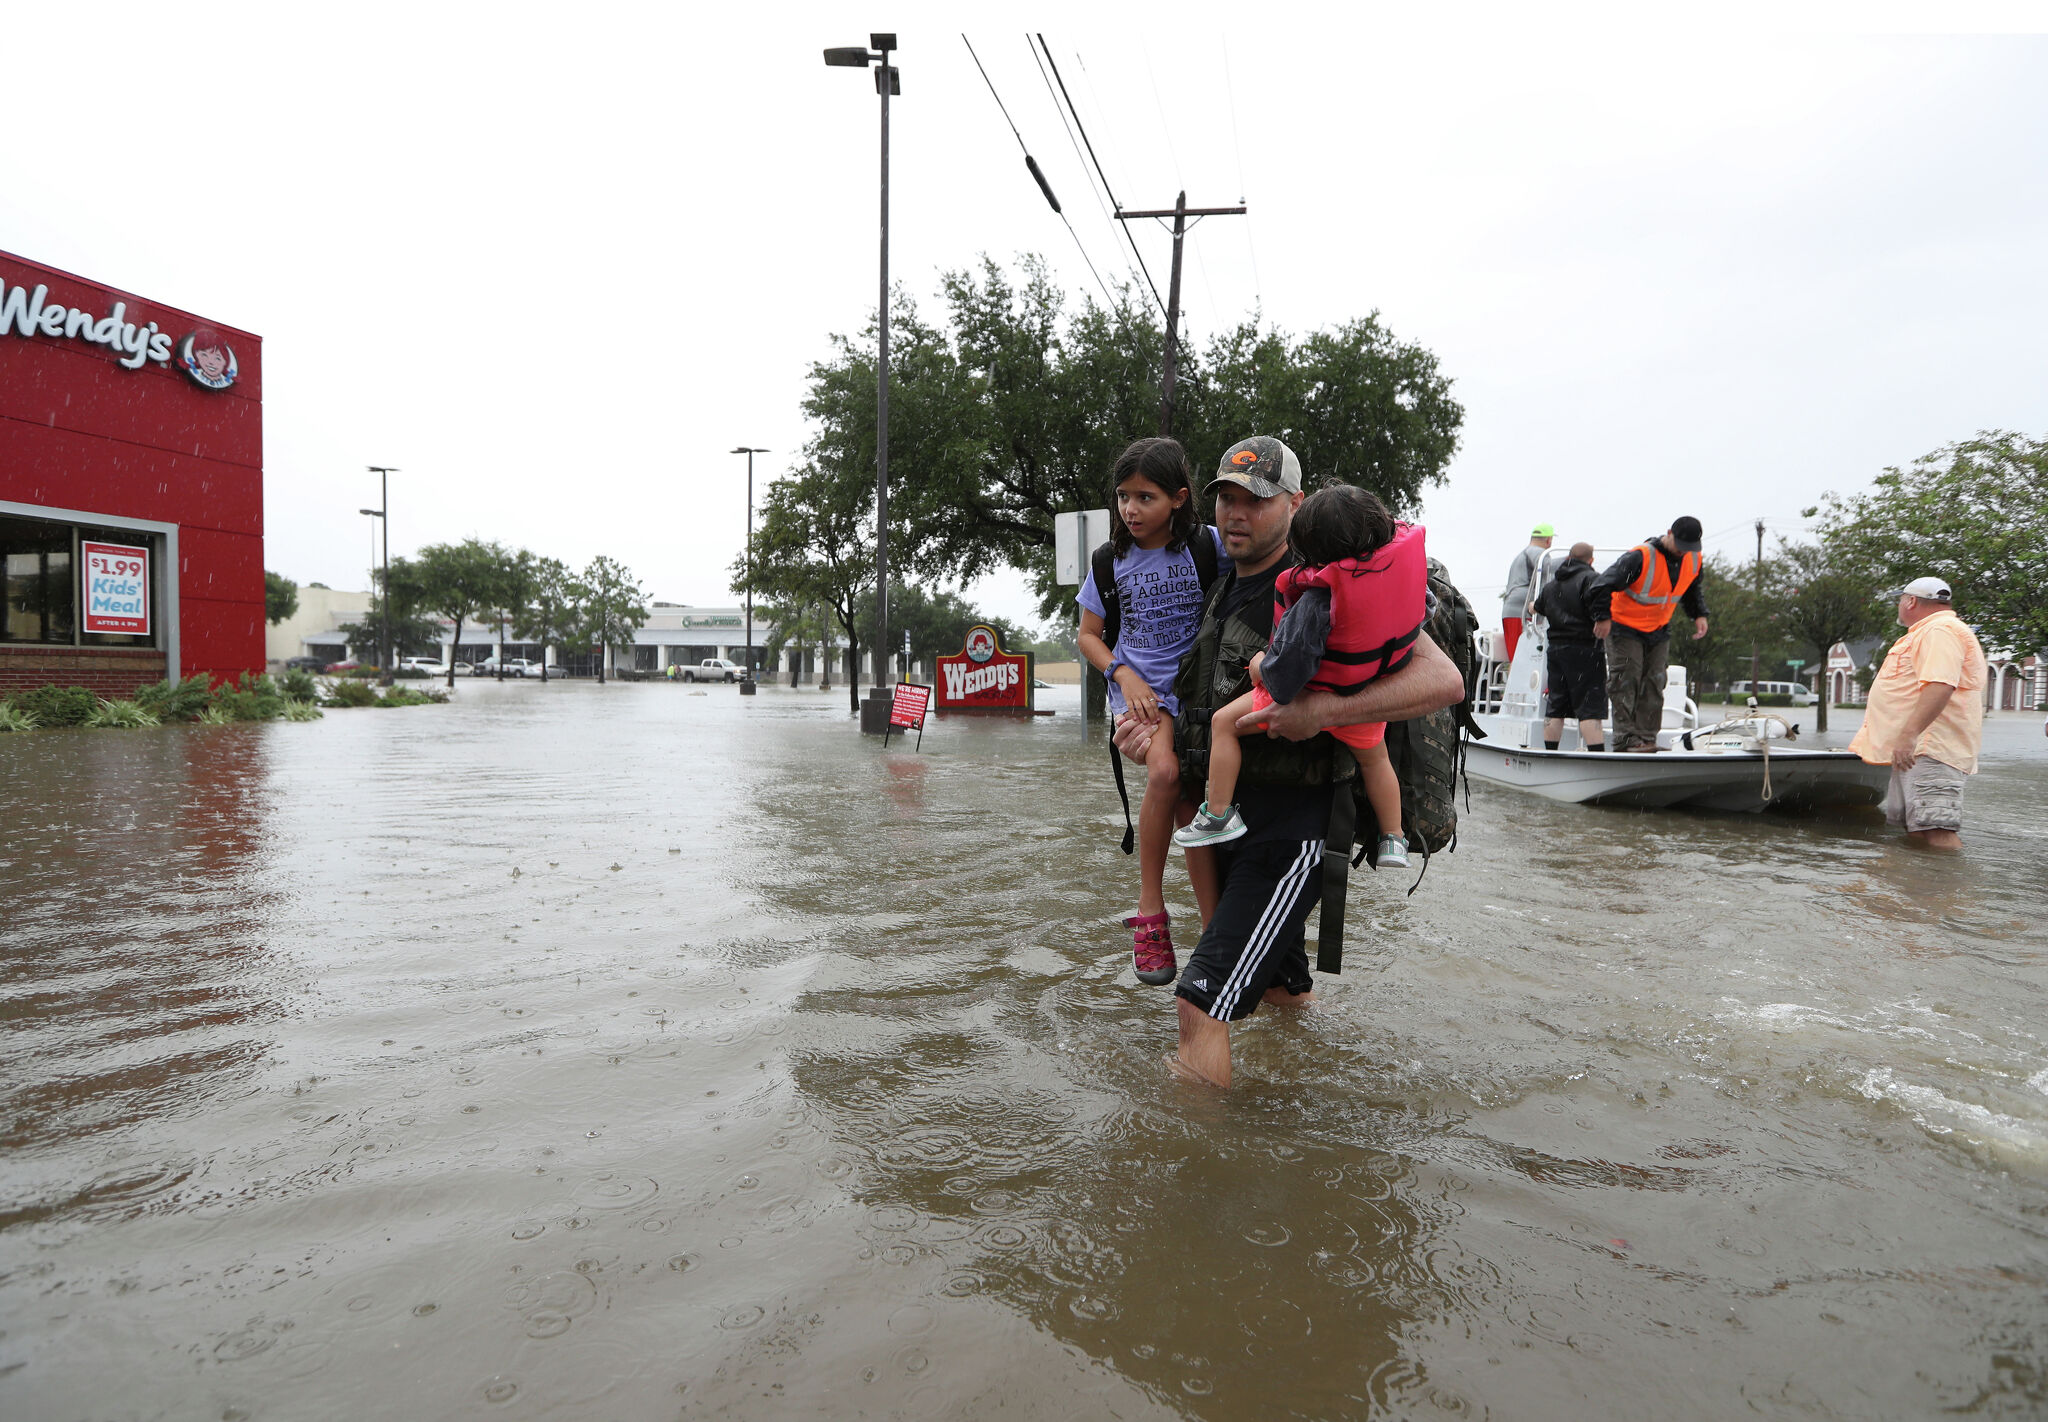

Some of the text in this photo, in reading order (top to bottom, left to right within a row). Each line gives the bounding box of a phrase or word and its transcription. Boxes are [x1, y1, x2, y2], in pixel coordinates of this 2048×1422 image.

[0, 277, 172, 369] Wendy's
[91, 558, 141, 577] $1.99
[1133, 564, 1195, 586] I'm Not
[92, 578, 142, 596] Kids'
[92, 596, 142, 613] Meal
[1133, 602, 1146, 611] To
[1145, 607, 1174, 620] Can
[1141, 625, 1154, 634] As
[1121, 634, 1150, 649] Finish
[1153, 630, 1182, 647] This
[1192, 981, 1207, 992] adidas
